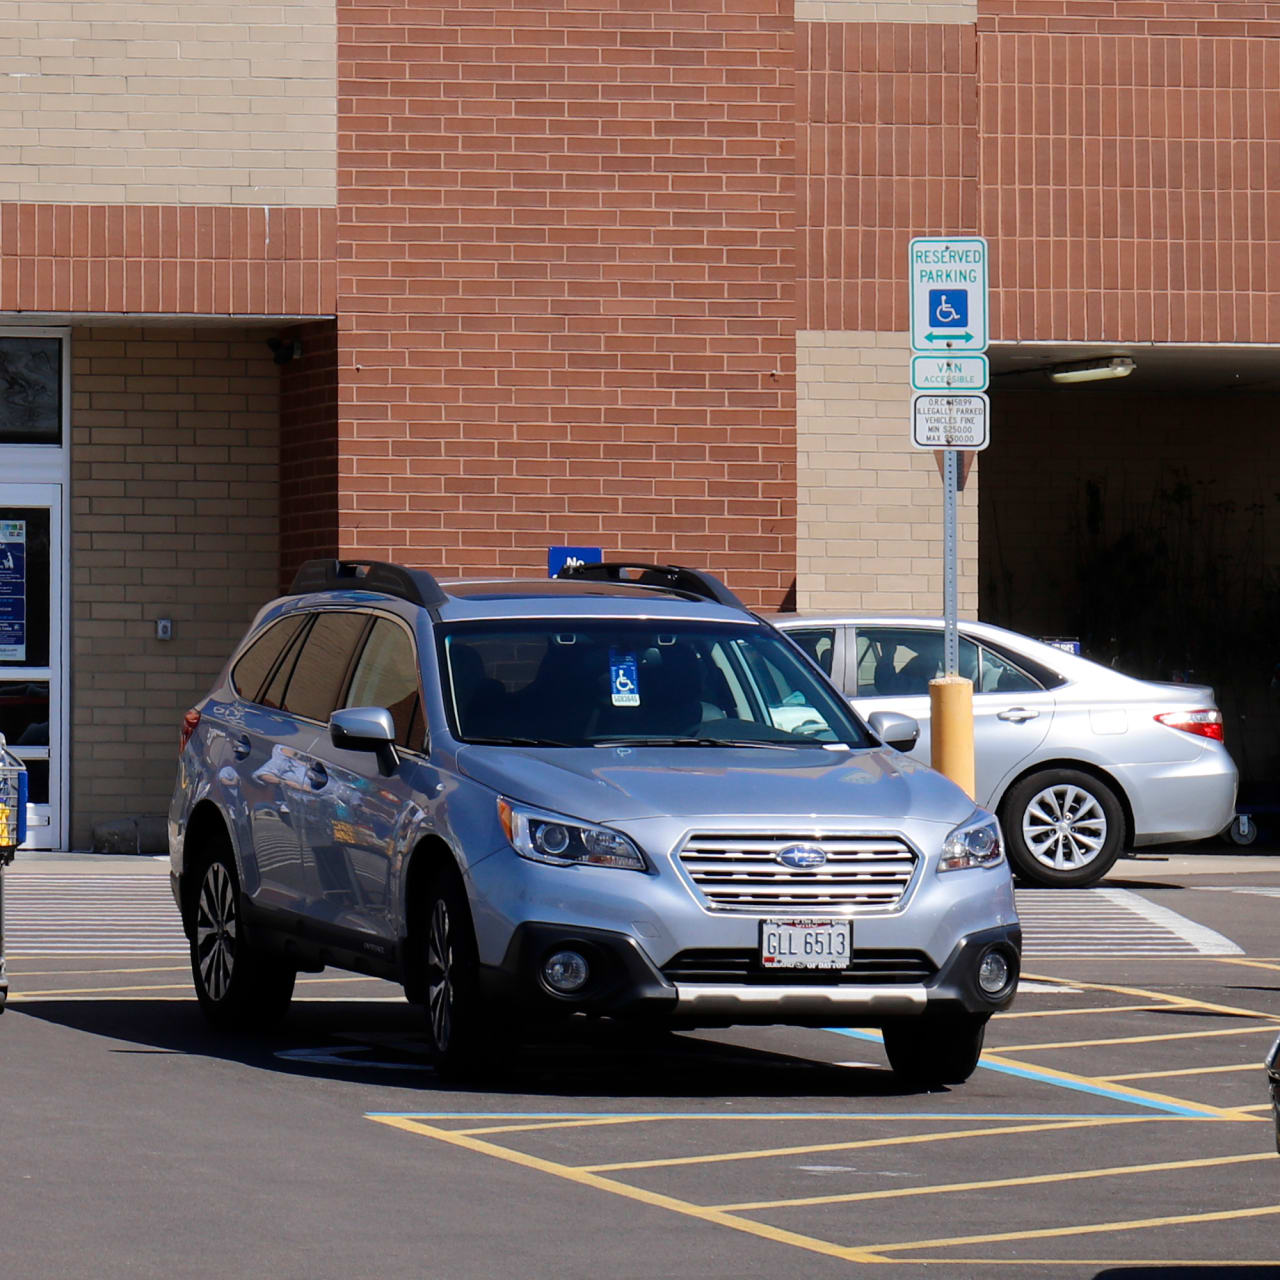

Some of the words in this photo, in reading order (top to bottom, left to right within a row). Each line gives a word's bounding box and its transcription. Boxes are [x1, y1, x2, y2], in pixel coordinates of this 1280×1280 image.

[916, 249, 981, 264] RESERVED
[919, 269, 977, 283] PARKING
[937, 363, 962, 374] VAN
[924, 375, 975, 384] ACCESSIBLE
[917, 408, 953, 416] ILLEGALLY
[956, 407, 983, 416] PARKED
[925, 416, 957, 425] VEHICLES
[960, 417, 976, 425] FINE
[767, 931, 798, 956] GLL
[804, 931, 846, 956] 6513
